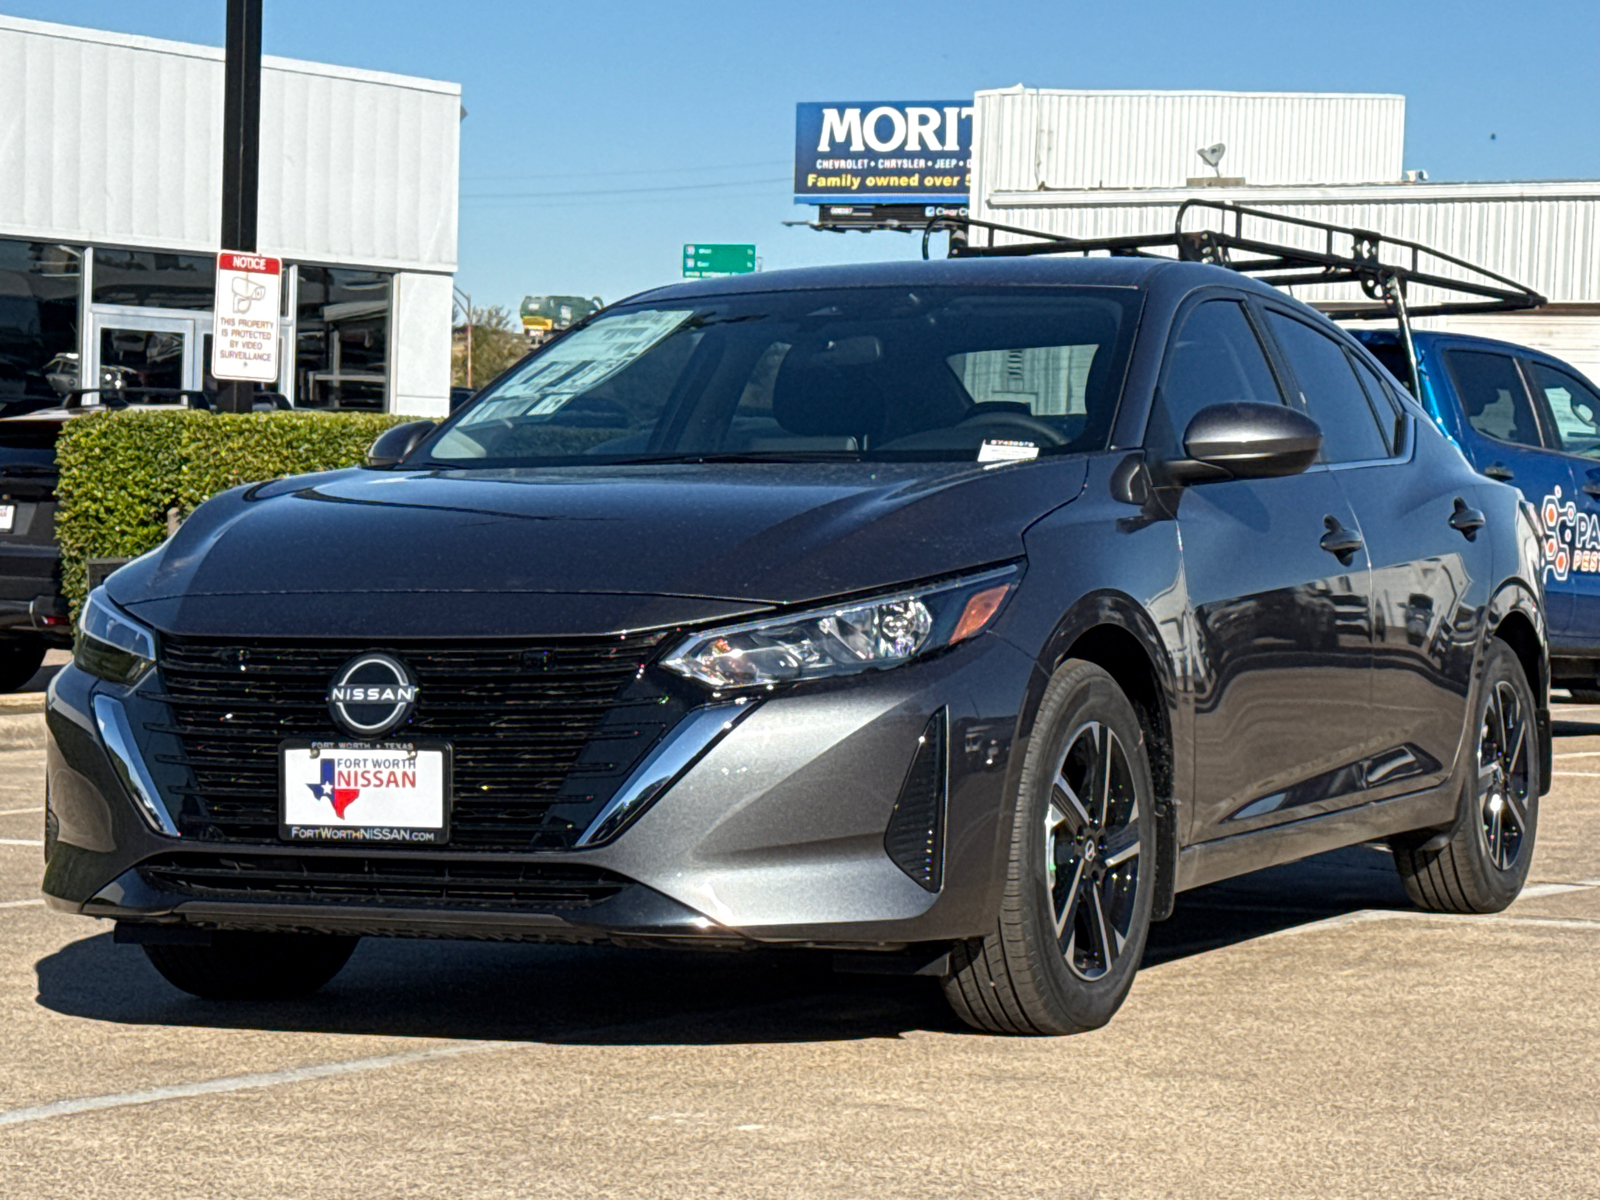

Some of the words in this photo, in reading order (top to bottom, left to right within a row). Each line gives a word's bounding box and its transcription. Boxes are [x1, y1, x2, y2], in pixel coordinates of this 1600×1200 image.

[815, 158, 869, 170] CHEVROLET
[877, 158, 926, 169] CHRYSLER
[934, 158, 957, 169] JEEP
[807, 173, 862, 190] Family
[865, 173, 920, 187] owned
[924, 176, 961, 187] over
[232, 256, 267, 270] NOTICE
[220, 317, 236, 327] THIS
[238, 318, 274, 330] PROPERTY
[221, 329, 229, 337] IS
[231, 329, 272, 341] PROTECTED
[229, 340, 239, 349] BY
[241, 341, 263, 350] VIDEO
[219, 350, 272, 362] SURVEILLANCE
[1572, 549, 1600, 573] PES
[331, 687, 415, 701] NISSAN
[311, 741, 335, 750] FORT
[338, 742, 371, 750] WORTH
[384, 742, 414, 751] TEXAS
[337, 758, 369, 769] FORT
[371, 758, 417, 770] WORTH
[337, 770, 417, 788] NISSAN
